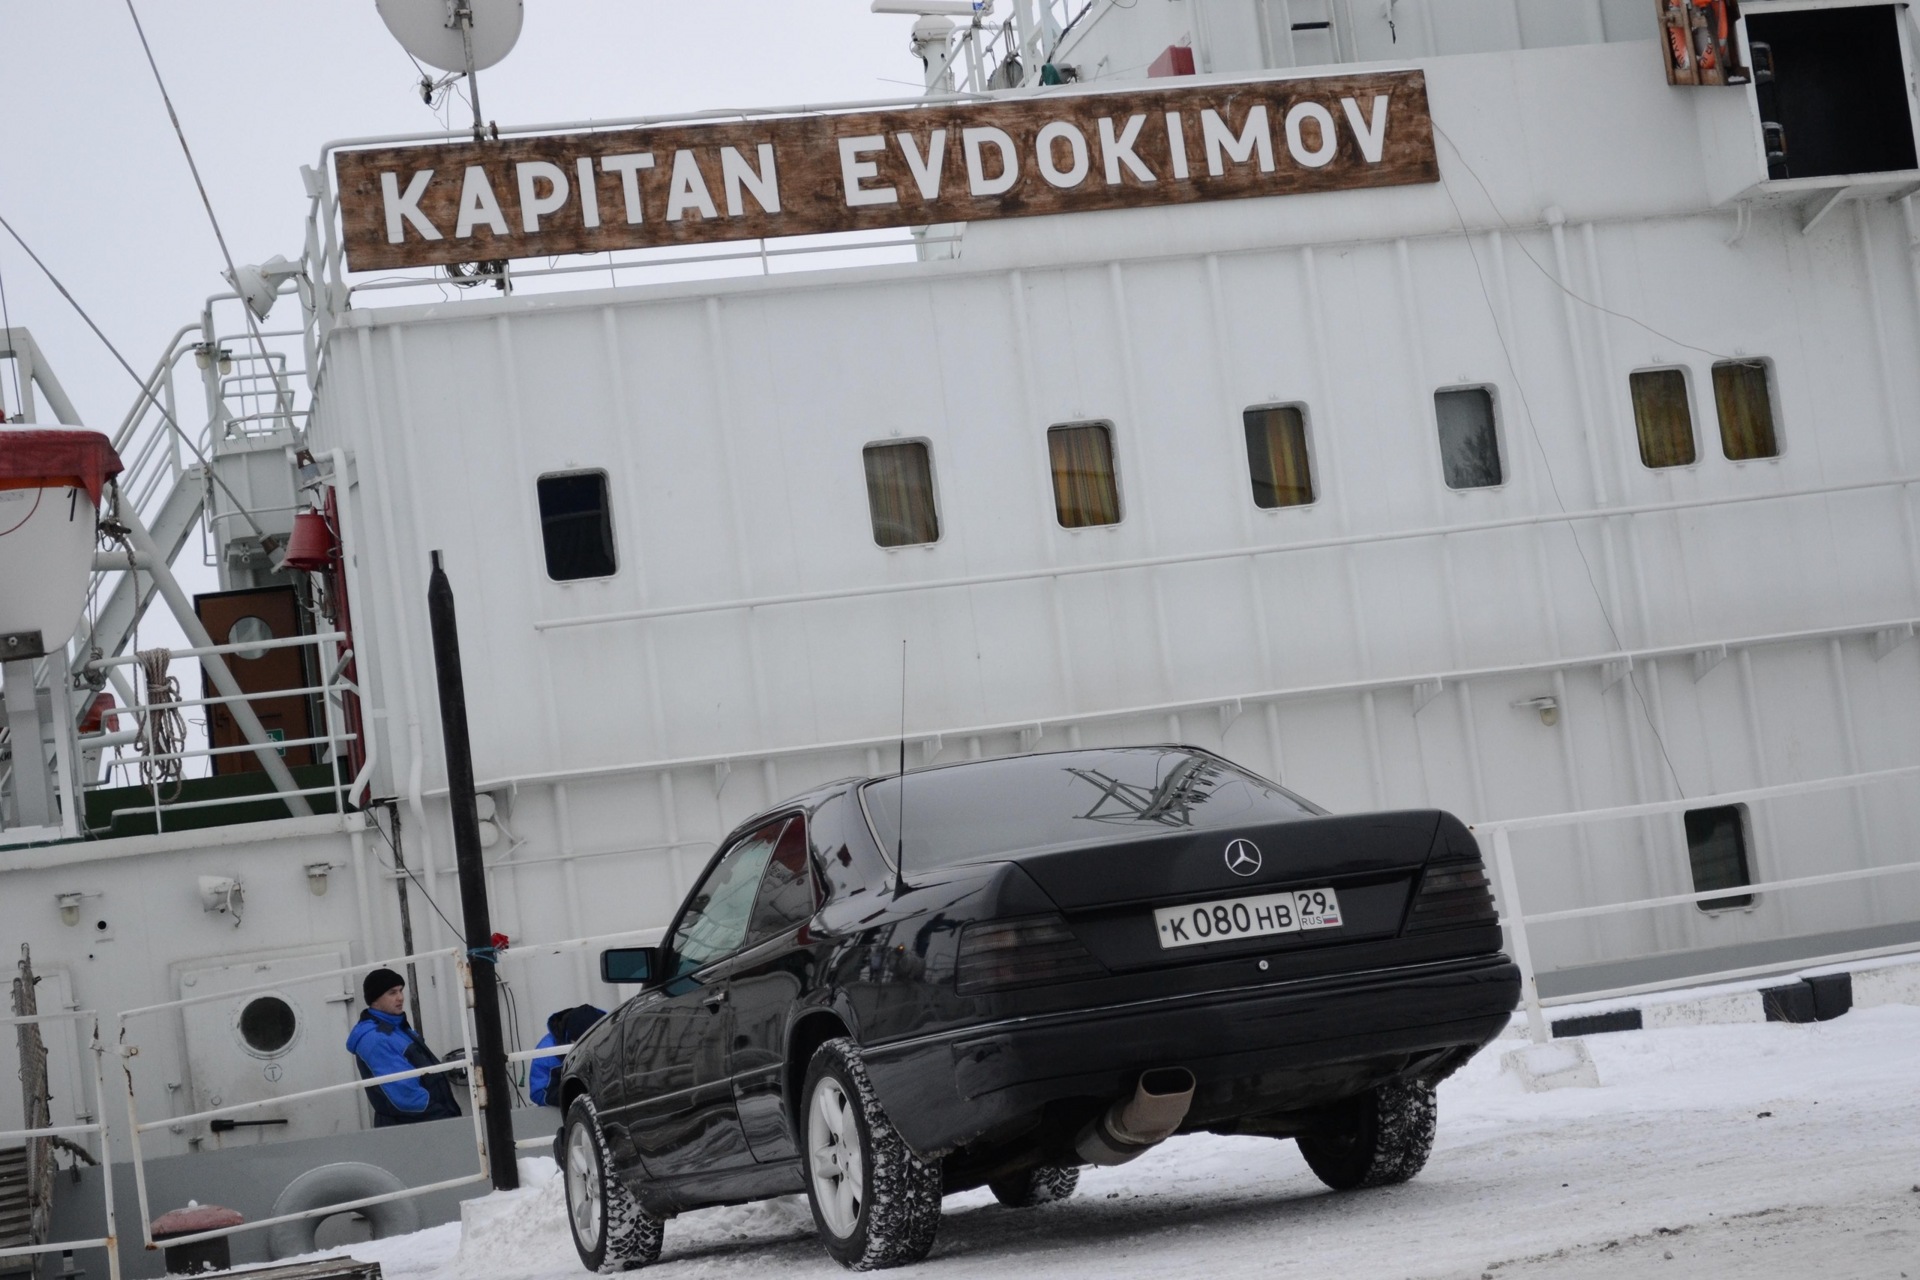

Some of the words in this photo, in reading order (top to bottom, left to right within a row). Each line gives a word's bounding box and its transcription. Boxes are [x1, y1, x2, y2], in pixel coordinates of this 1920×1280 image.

[381, 144, 781, 243] KAPITAN
[838, 95, 1389, 206] EVDOKIMOV
[1297, 891, 1327, 916] 29
[1301, 915, 1323, 926] RUS
